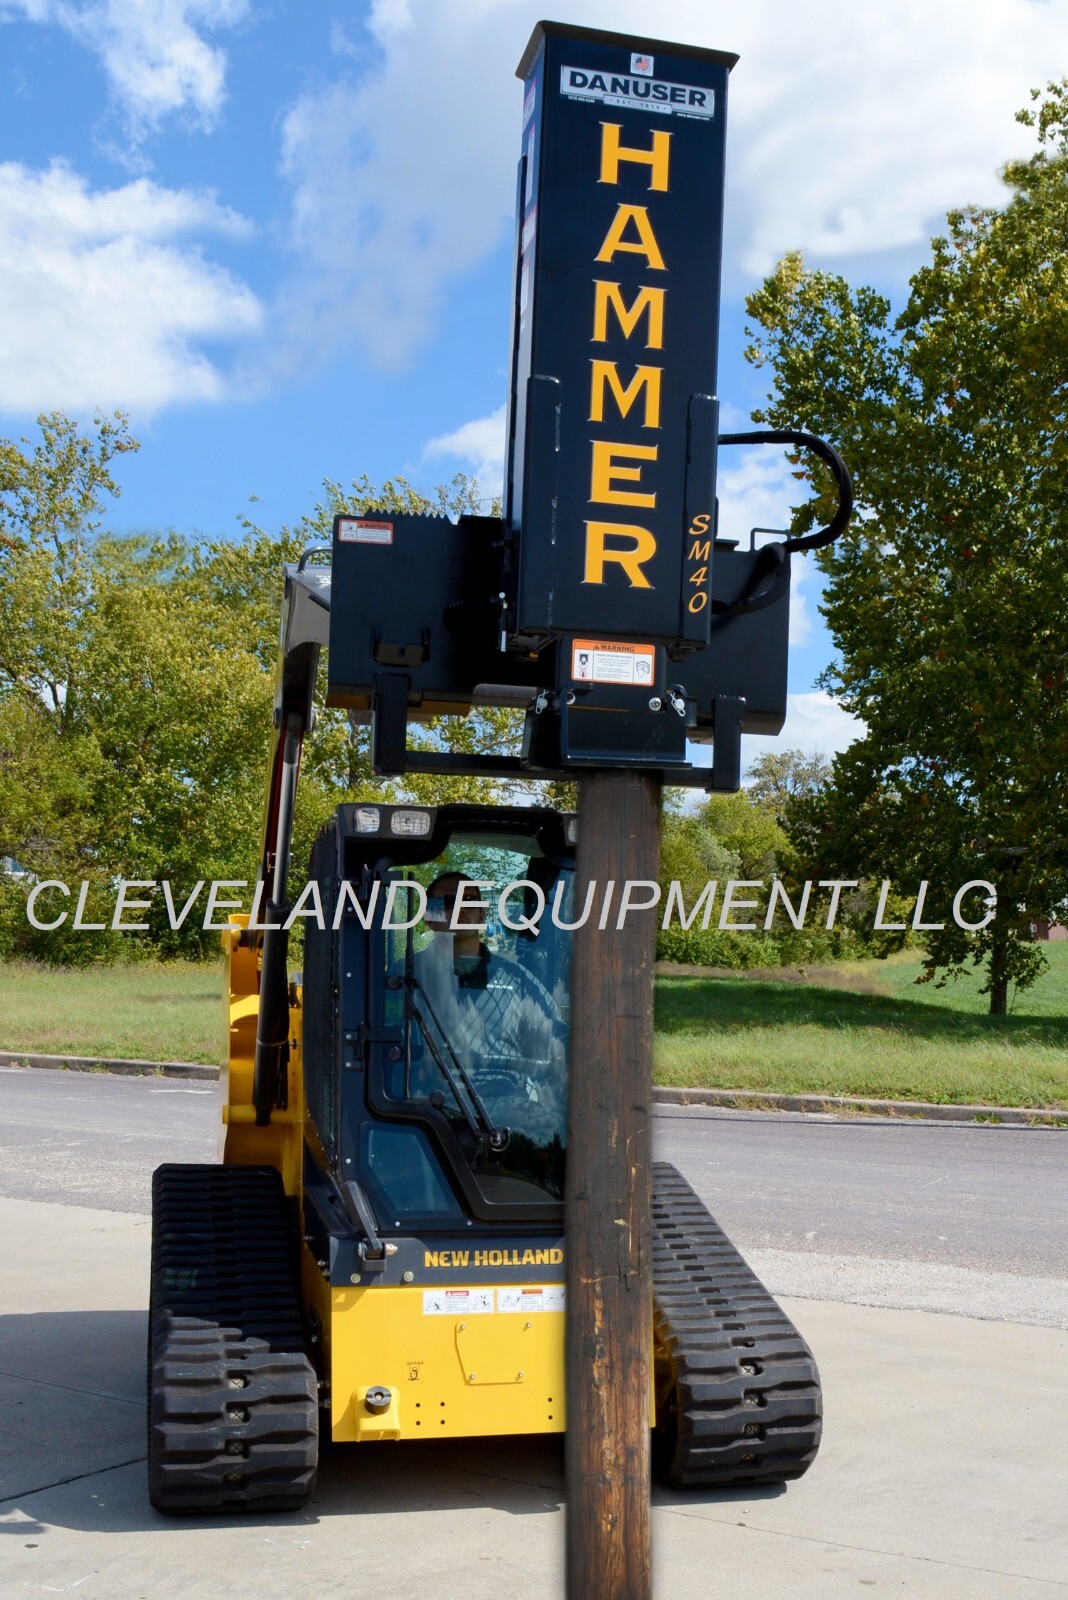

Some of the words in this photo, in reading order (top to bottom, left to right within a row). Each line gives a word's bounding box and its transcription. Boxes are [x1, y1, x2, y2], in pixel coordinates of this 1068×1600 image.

[569, 71, 707, 108] DANUSER
[580, 121, 673, 590] HAMMER
[688, 514, 711, 613] SM40
[601, 644, 635, 652] WARNING
[424, 1250, 470, 1268] NEW
[474, 1248, 564, 1267] HOLLAND
